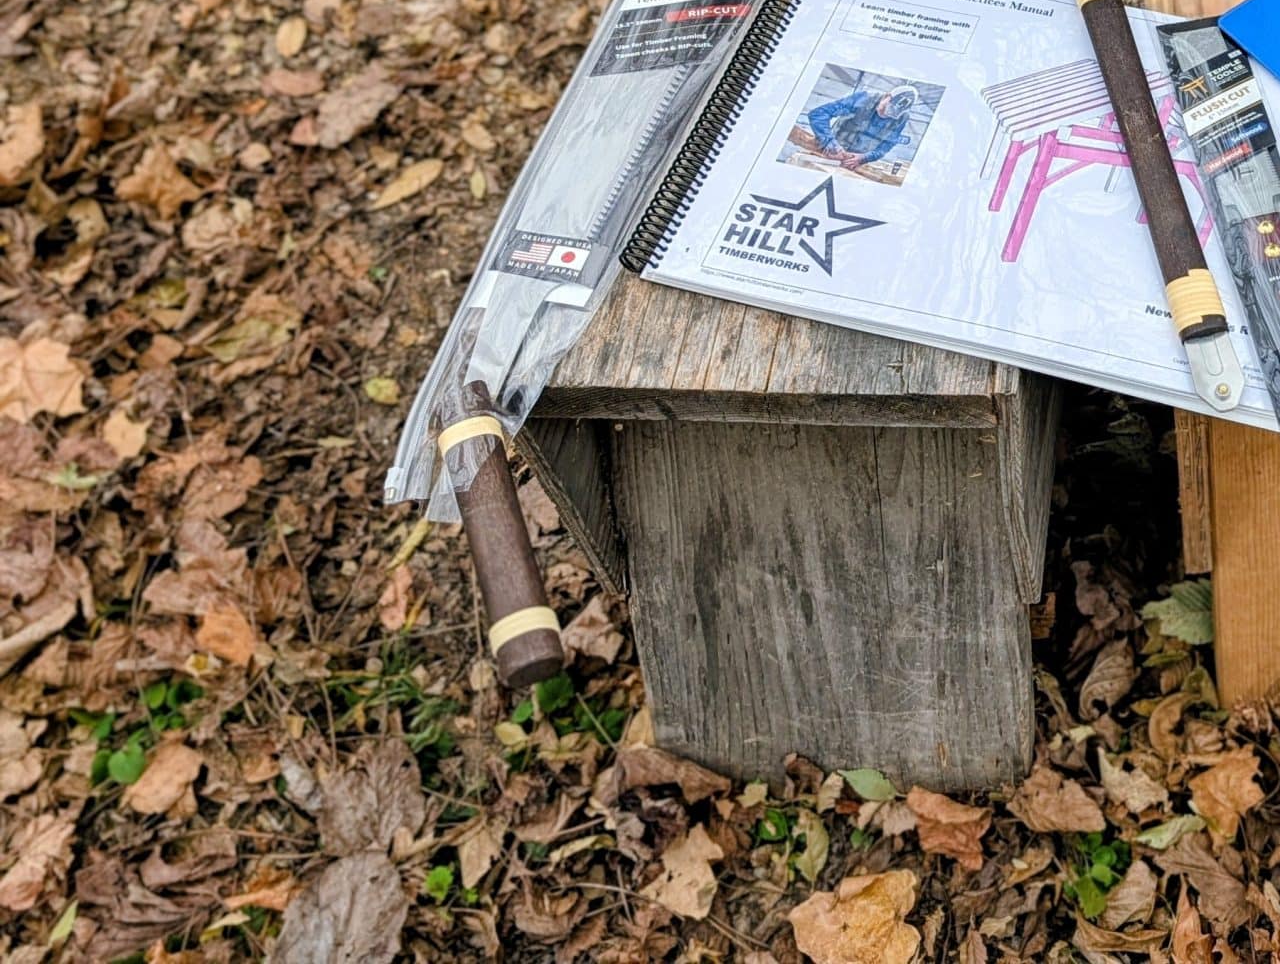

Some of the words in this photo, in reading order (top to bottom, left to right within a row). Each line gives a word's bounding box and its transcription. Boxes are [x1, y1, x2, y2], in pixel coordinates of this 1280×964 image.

[687, 6, 739, 18] RIP-CUT
[861, 2, 886, 12] Learn
[887, 8, 916, 18] timber
[917, 14, 950, 26] framing
[951, 20, 971, 29] with
[872, 14, 889, 22] this
[1009, 1, 1055, 18] Manual
[1207, 58, 1242, 77] TEMPLE
[1190, 98, 1228, 121] FLUSH
[1228, 85, 1252, 102] CUT
[734, 204, 820, 237] STAR
[521, 234, 562, 245] DESIGNED
[575, 241, 592, 250] USA
[723, 223, 795, 257] HILL
[718, 245, 810, 273] TIMBERWORKS
[507, 260, 532, 270] MADE
[549, 267, 580, 278] JAPAN
